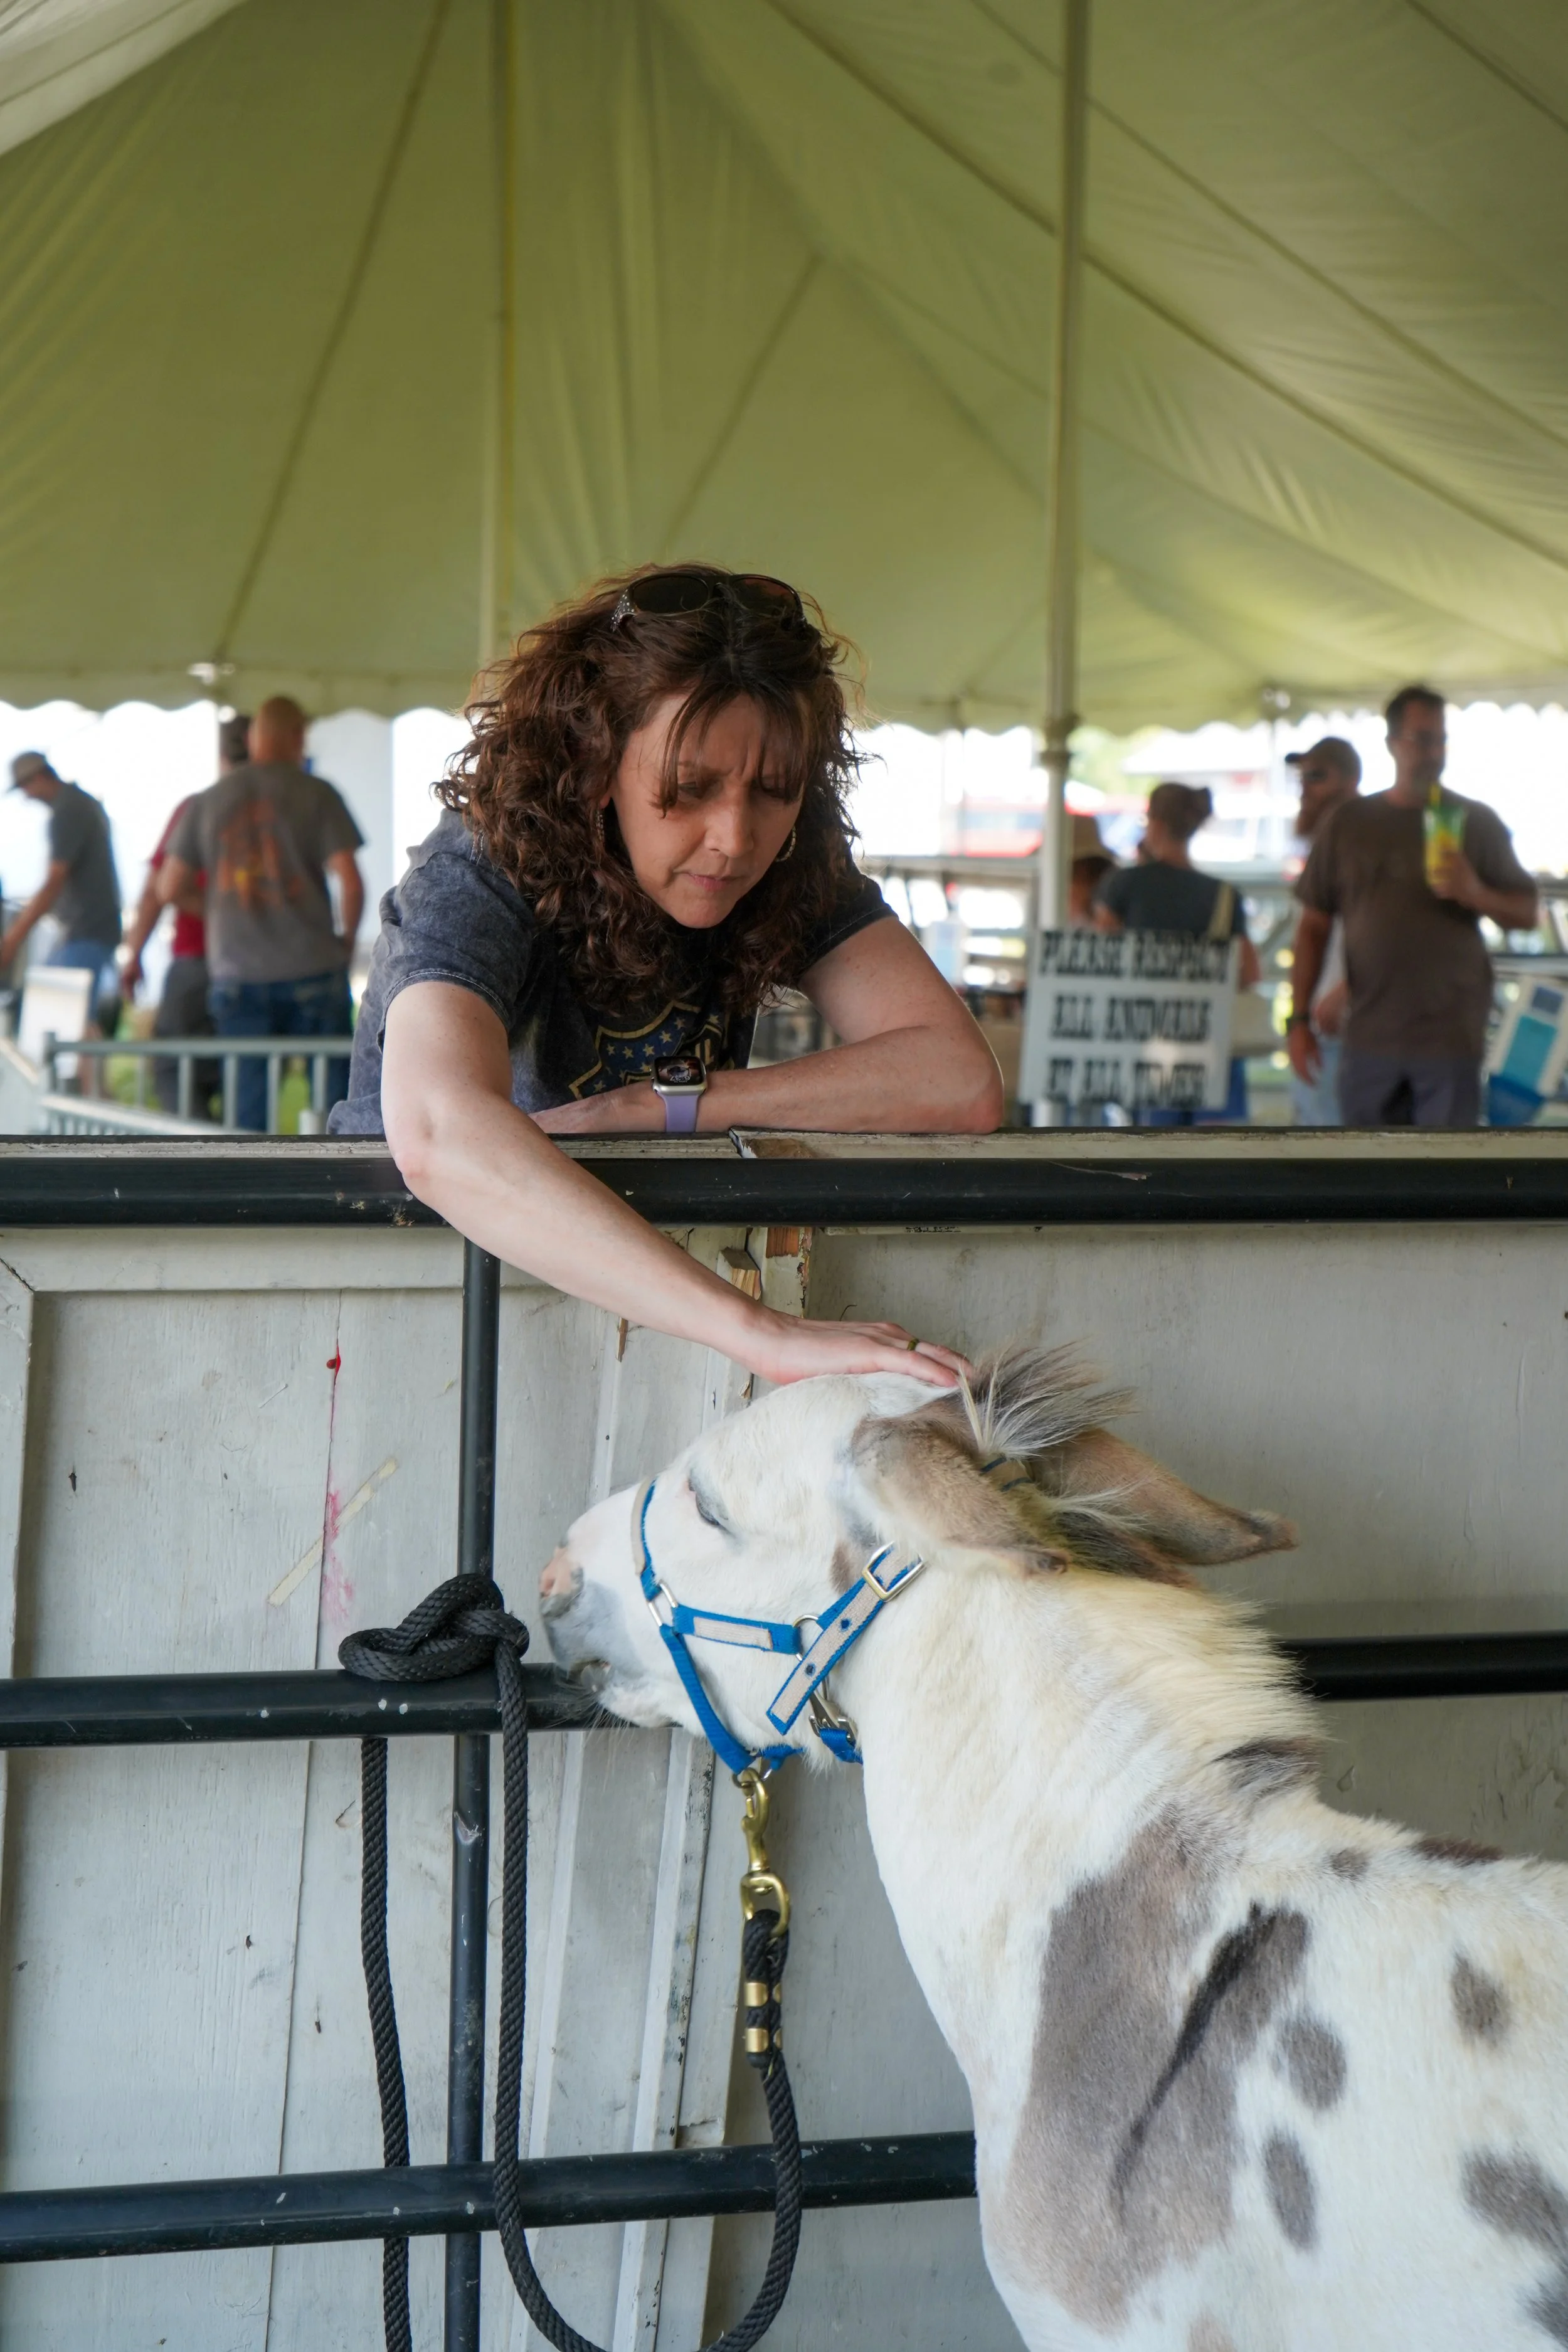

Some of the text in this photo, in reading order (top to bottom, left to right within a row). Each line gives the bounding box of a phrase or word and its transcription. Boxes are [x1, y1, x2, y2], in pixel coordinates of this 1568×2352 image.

[1039, 931, 1228, 983] PLEASE RESPECT
[1050, 994, 1211, 1042] ALL ANIMALS
